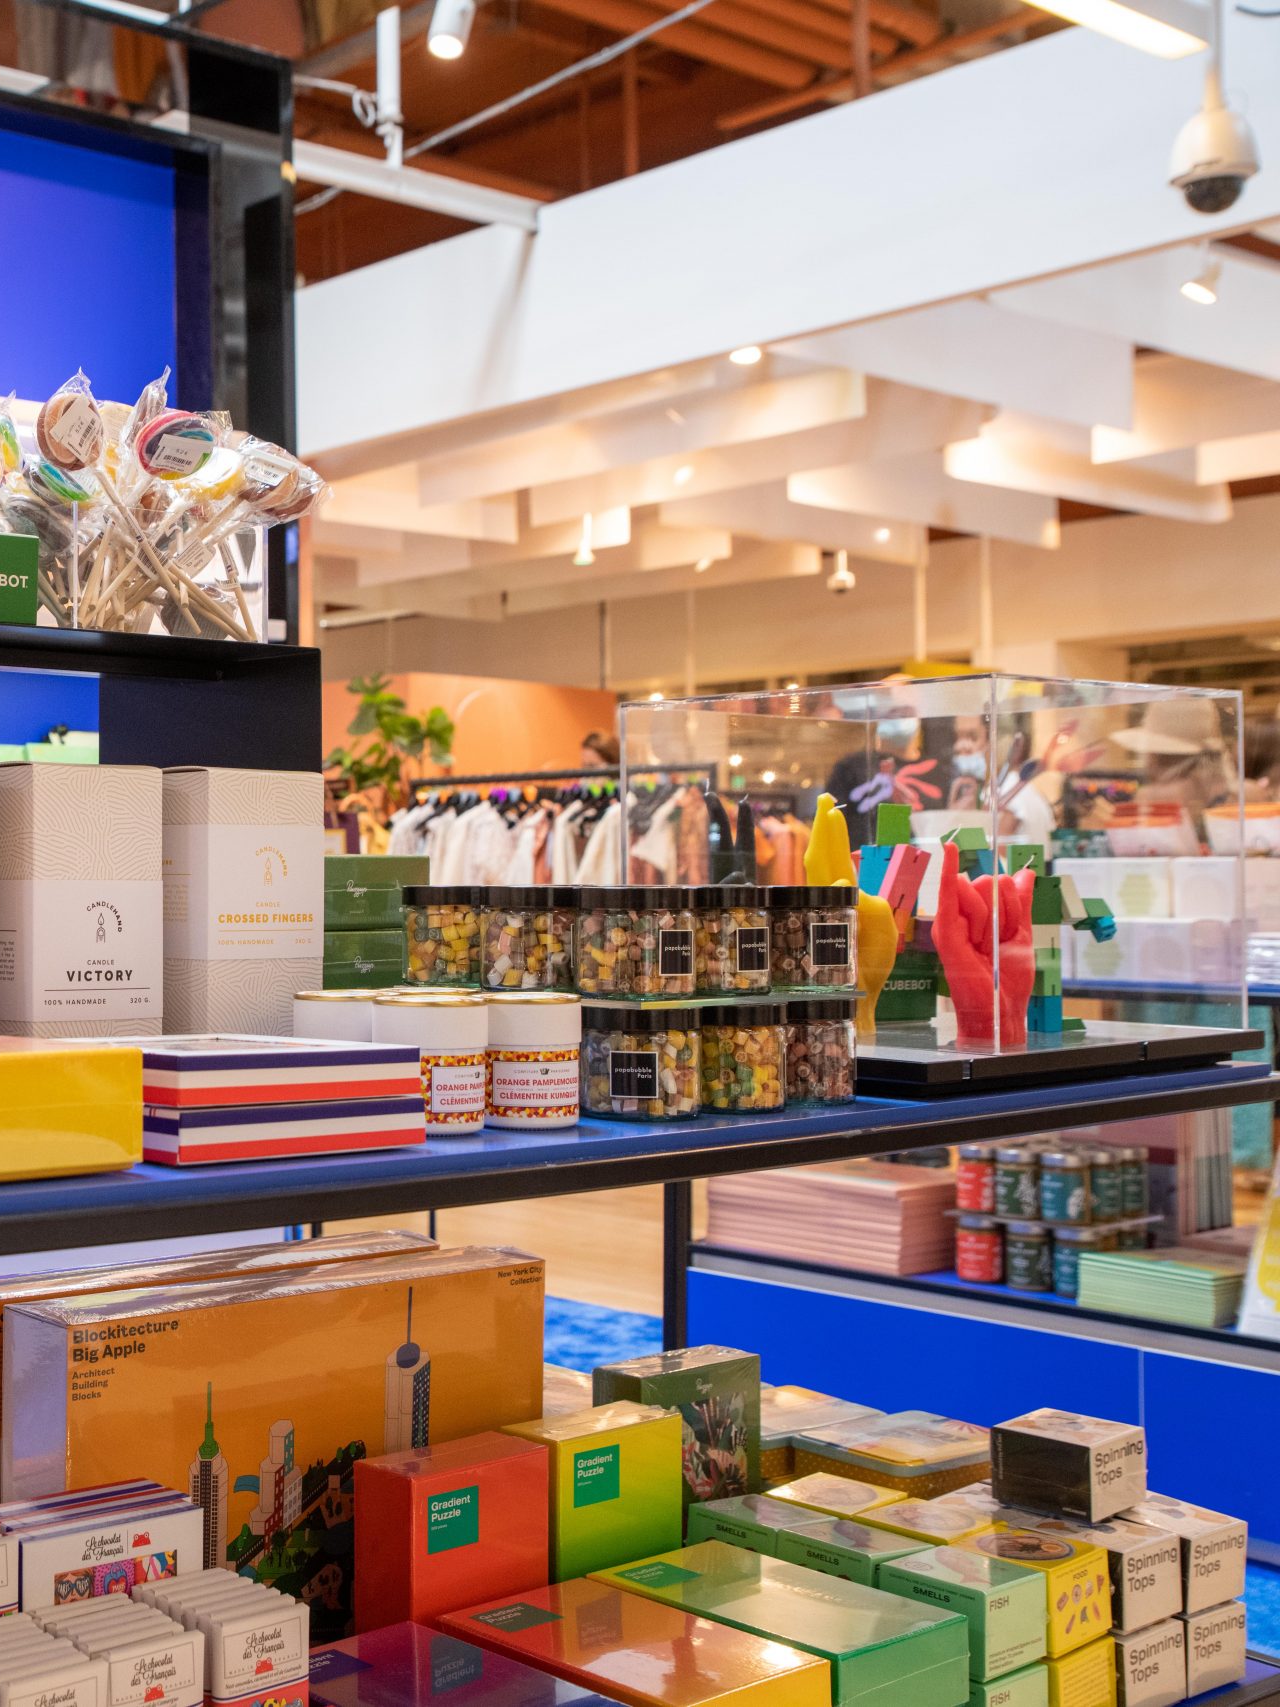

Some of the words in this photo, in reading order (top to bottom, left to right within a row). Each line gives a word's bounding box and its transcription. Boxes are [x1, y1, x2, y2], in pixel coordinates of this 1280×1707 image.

[86, 900, 123, 933] CANDLEHAND
[218, 913, 270, 924] CROSSED
[272, 913, 314, 923] FINGERS
[66, 969, 133, 982] VICTORY
[882, 979, 932, 991] CUBEBOT
[436, 1083, 469, 1092] ORANGE
[496, 1078, 530, 1086] ORANGE
[532, 1076, 578, 1086] PAMPLEMOUSS
[440, 1097, 479, 1106] CLÉMENTINE
[499, 1090, 548, 1100] CLÉMENTINE
[497, 1271, 512, 1279] New
[512, 1268, 529, 1276] York
[529, 1266, 543, 1274] City
[510, 1276, 543, 1286] Collection
[72, 1319, 180, 1344] Blockitecture
[72, 1348, 99, 1363] Big
[102, 1341, 146, 1359] Apple
[72, 1368, 115, 1380] Architect
[72, 1379, 109, 1391] Building
[72, 1391, 102, 1402] Blocks
[577, 1453, 613, 1469] Gradient
[1095, 1439, 1144, 1469] Spinning
[577, 1466, 604, 1479] Puzzle
[1096, 1466, 1123, 1486] Tops
[431, 1494, 471, 1512] Gradient
[431, 1508, 462, 1523] Puzzle
[716, 1524, 747, 1538] SMELLS
[1193, 1532, 1245, 1563] Spinning
[806, 1550, 840, 1566] SMELLS
[1127, 1547, 1178, 1576] Spinning
[1073, 1570, 1088, 1580] FOOD
[1193, 1558, 1222, 1580] Tops
[1128, 1572, 1156, 1593] Tops
[912, 1586, 950, 1603] SMELLS
[990, 1596, 1010, 1612] FISH
[1193, 1612, 1246, 1642] Spinning
[246, 1632, 258, 1648] Le
[258, 1627, 282, 1642] chocolat
[242, 1648, 253, 1660] des
[1128, 1631, 1183, 1667] Spinning
[1193, 1639, 1222, 1662] Tops
[147, 1653, 173, 1670] chocolat
[1130, 1660, 1160, 1685] Tops
[130, 1674, 141, 1688] des
[990, 1690, 1011, 1707] FISH
